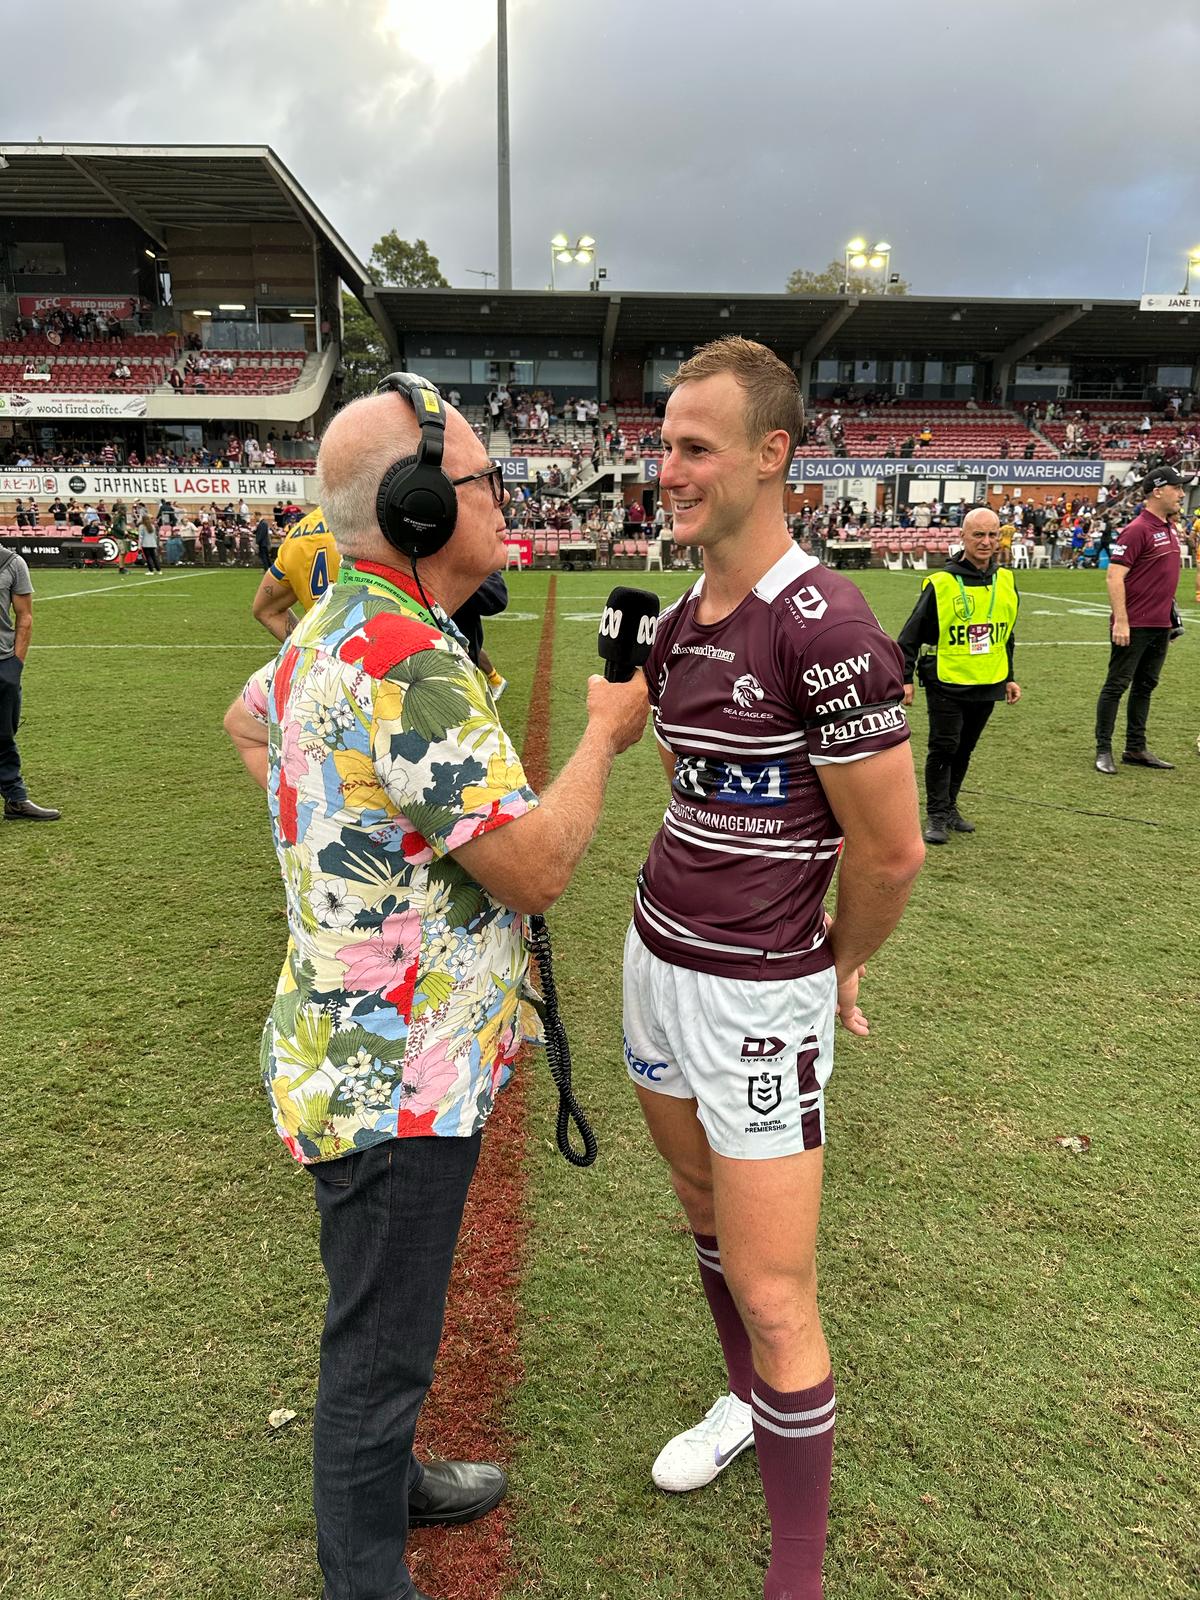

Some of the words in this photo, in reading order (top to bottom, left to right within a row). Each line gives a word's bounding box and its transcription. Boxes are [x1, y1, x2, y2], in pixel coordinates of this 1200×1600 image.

[35, 297, 60, 310] KFC
[1168, 299, 1191, 307] JANE
[37, 404, 62, 413] wood
[65, 404, 88, 414] fired
[91, 404, 122, 414] coffee.
[806, 463, 855, 476] SALON
[1013, 465, 1101, 478] WAREHOUSE
[94, 477, 168, 494] JAPANESE
[174, 478, 231, 494] LAGER
[238, 479, 267, 495] BAR
[309, 547, 334, 601] 4
[355, 576, 373, 584] TELSTRA
[374, 581, 408, 603] PREMIERSHIP
[784, 597, 807, 630] DYNASTY
[802, 652, 871, 697] Shaw
[815, 683, 862, 716] and
[722, 707, 737, 716] SEA
[738, 710, 774, 719] EAGLES
[696, 809, 785, 834] MANAGEMENT
[744, 1123, 787, 1134] PREMIERSHIP
[760, 1119, 782, 1127] TELSTRA
